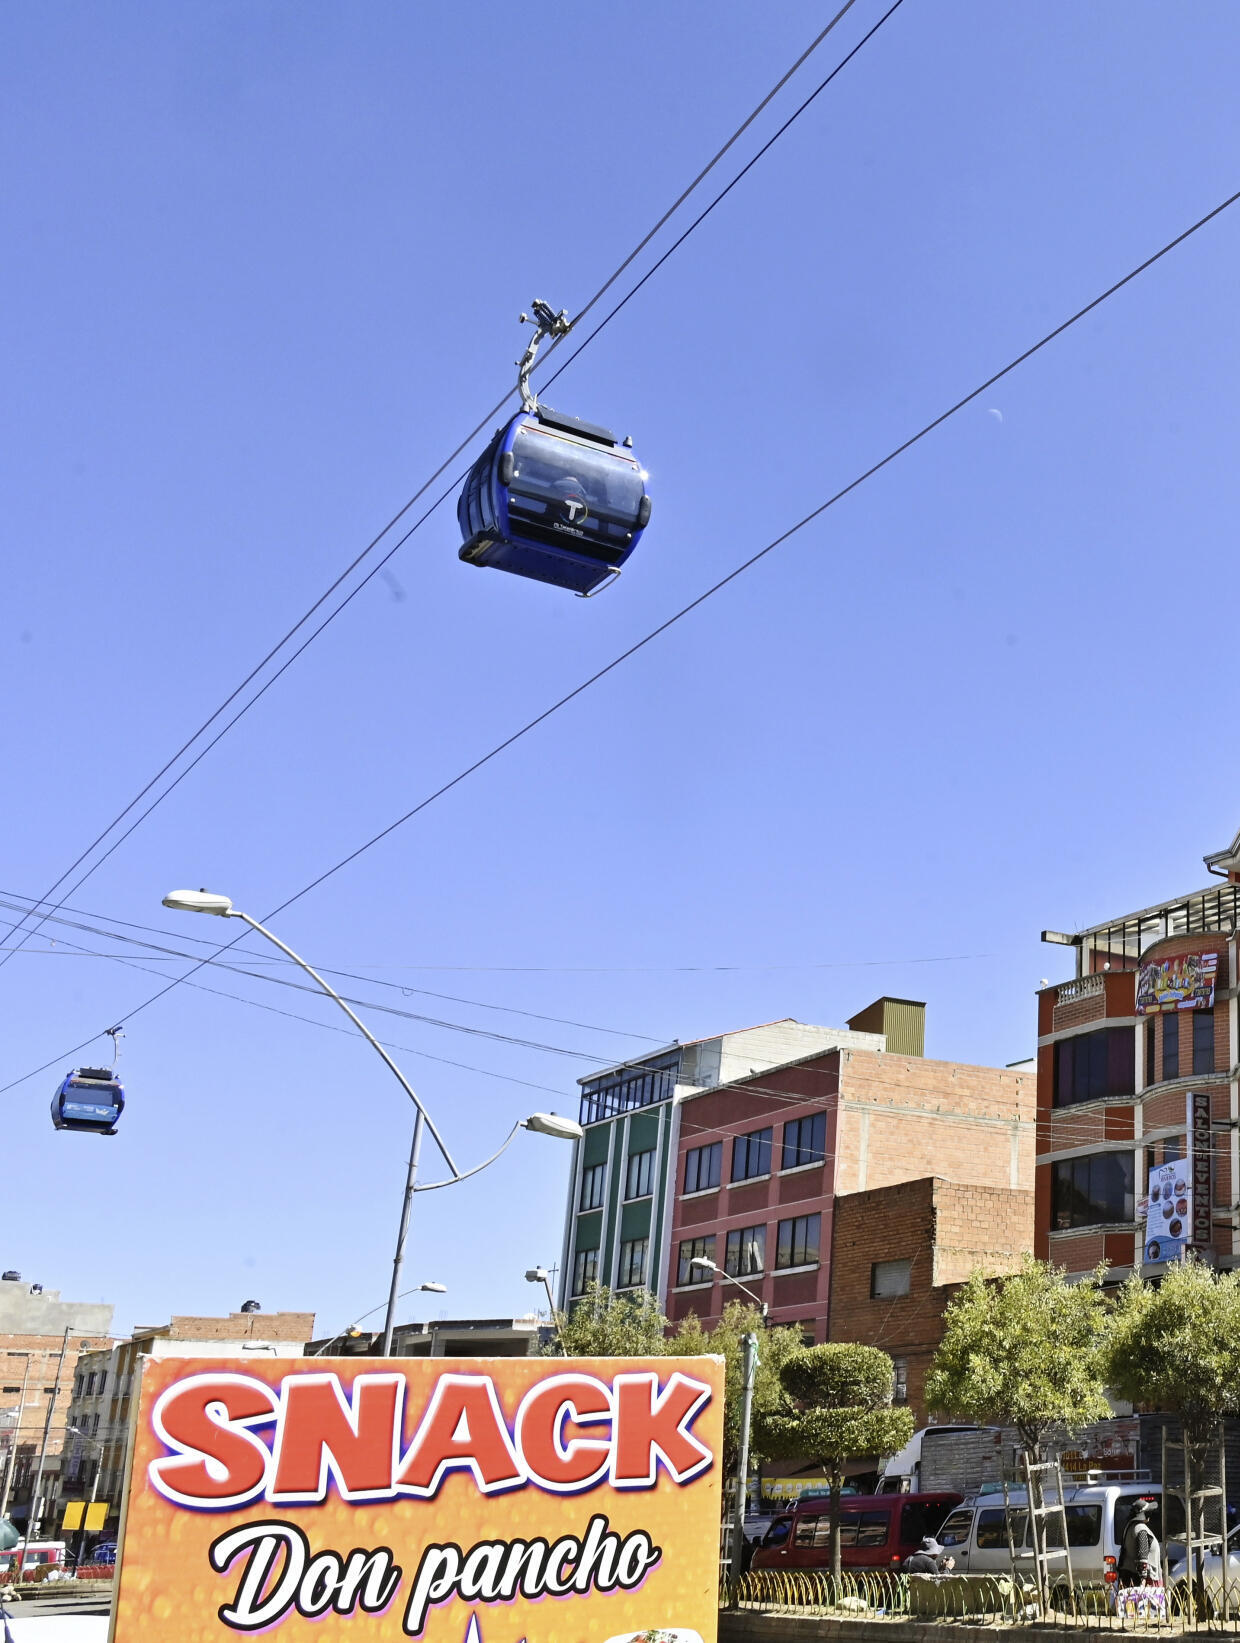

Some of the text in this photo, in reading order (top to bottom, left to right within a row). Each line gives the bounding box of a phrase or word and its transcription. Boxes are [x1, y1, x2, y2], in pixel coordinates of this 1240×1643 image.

[1195, 1096, 1209, 1151] SALON
[1195, 1162, 1209, 1241] EVENTOS
[151, 1374, 713, 1509] SNACK
[210, 1514, 661, 1636] Don pancho
